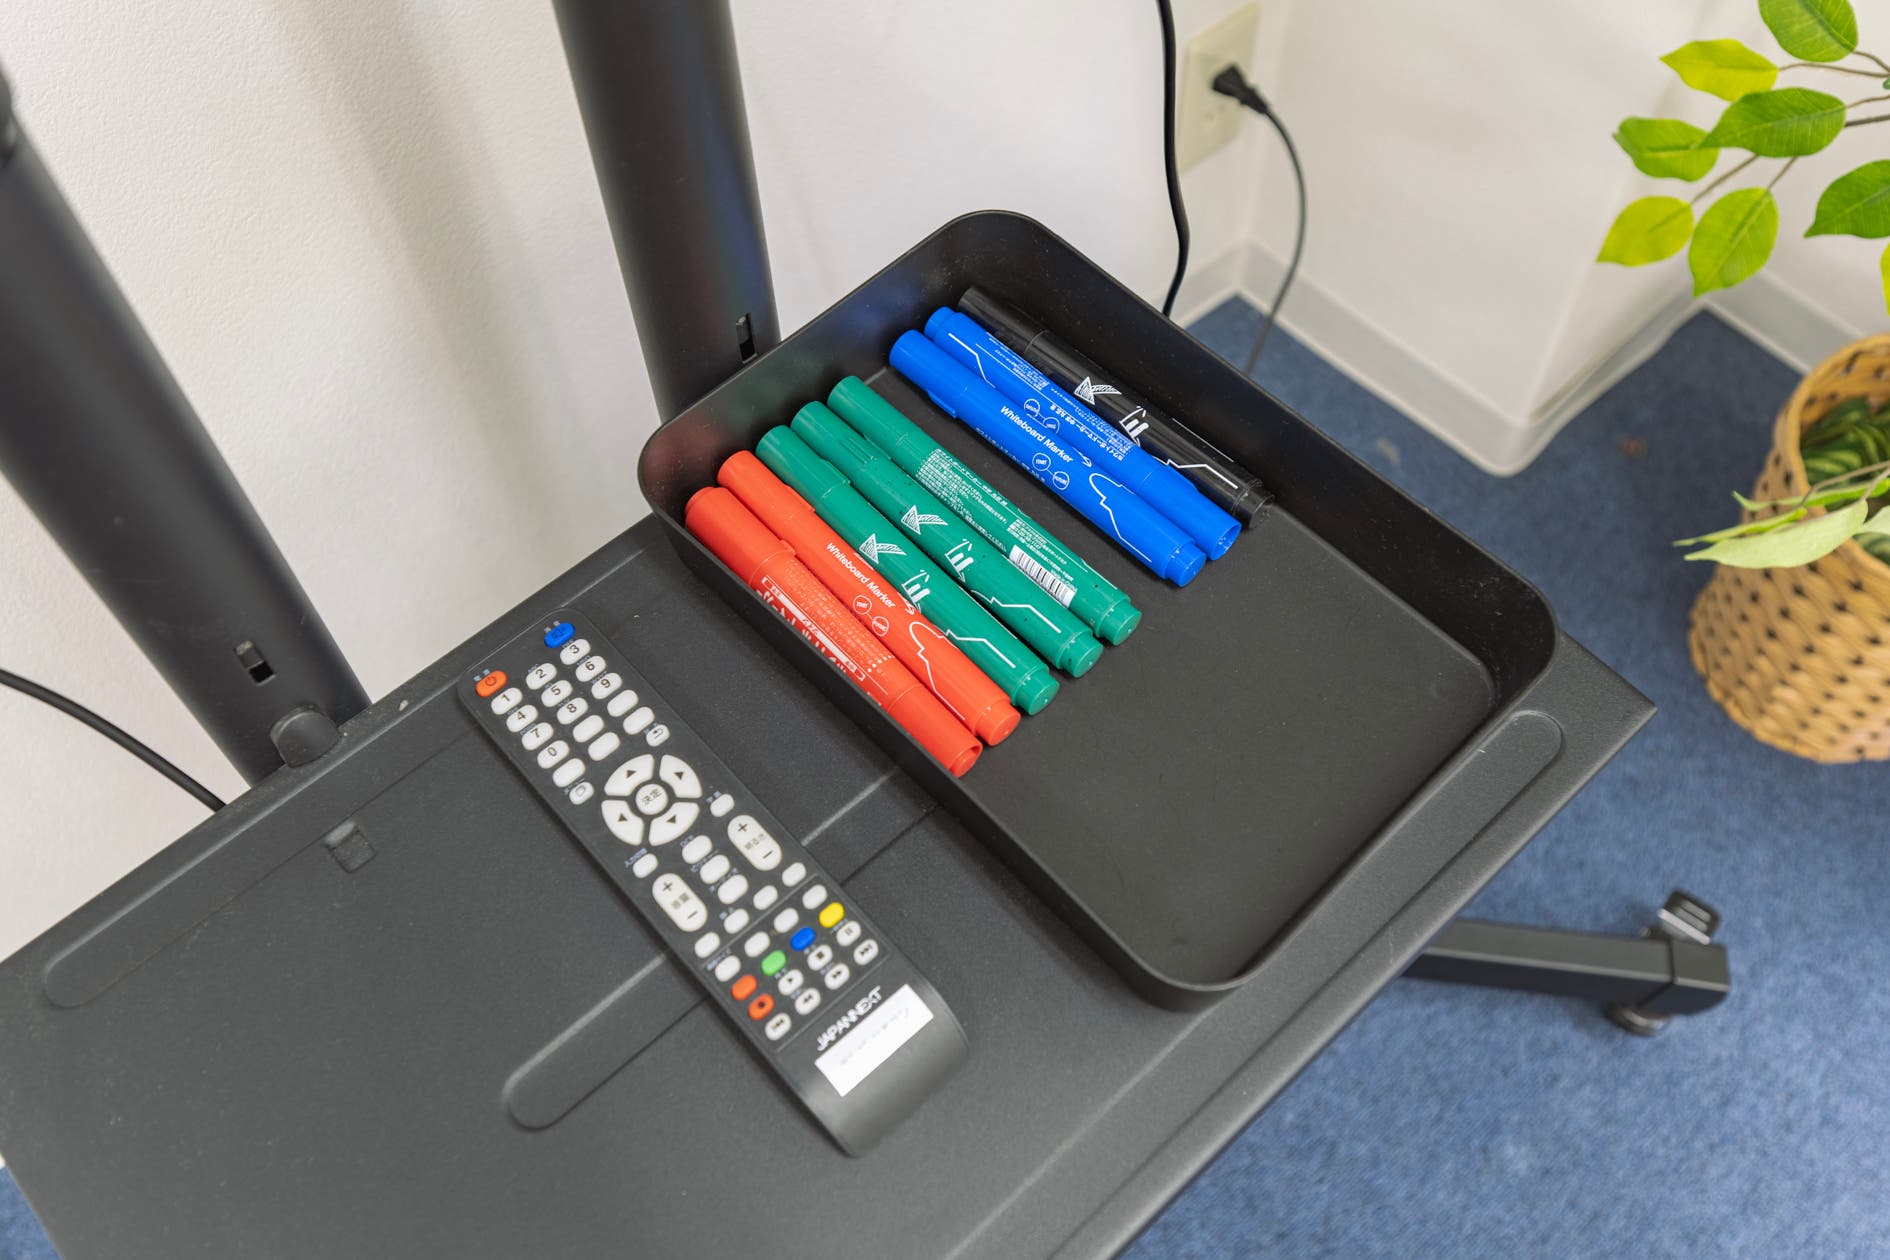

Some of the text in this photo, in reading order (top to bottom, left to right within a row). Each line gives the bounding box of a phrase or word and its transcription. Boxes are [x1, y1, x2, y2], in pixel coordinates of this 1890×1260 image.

[1000, 405, 1045, 442] Whiteboard
[1044, 438, 1073, 463] Marker
[826, 542, 895, 608] Whiteboard Marker
[569, 644, 579, 654] 3
[585, 660, 595, 671] 6
[536, 668, 545, 678] 2
[601, 678, 610, 688] 9
[551, 685, 560, 695] 5
[502, 693, 509, 702] 1
[567, 703, 576, 713] 8
[516, 710, 525, 721] 4
[531, 728, 541, 738] 7
[547, 746, 557, 757] 0
[641, 788, 661, 805] 決定
[816, 985, 881, 1050] JAPANNEXT
